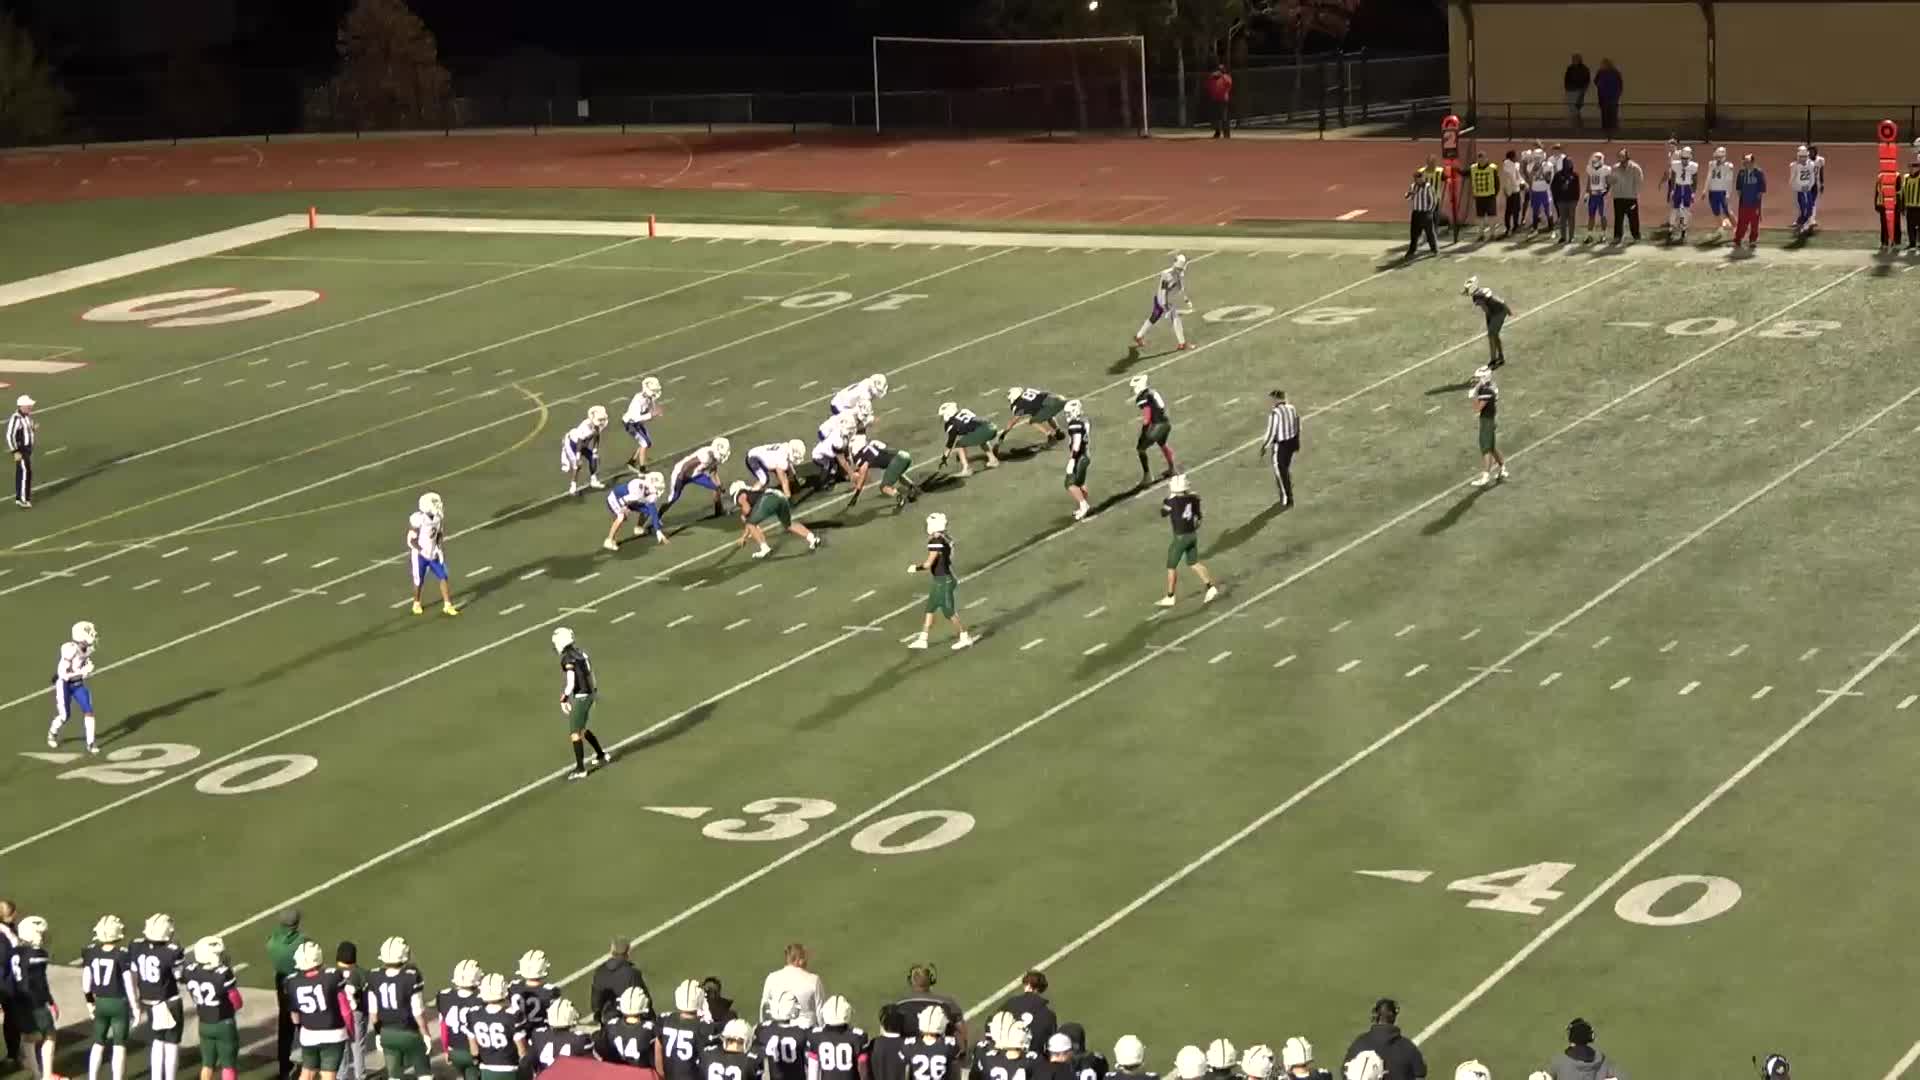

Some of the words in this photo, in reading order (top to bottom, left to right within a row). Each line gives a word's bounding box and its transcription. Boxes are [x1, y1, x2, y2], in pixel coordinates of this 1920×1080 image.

[1182, 503, 1193, 521] 4
[701, 797, 976, 854] 30
[1446, 861, 1742, 926] 40
[91, 958, 115, 987] 17
[137, 953, 160, 983] 16
[187, 980, 221, 1007] 32
[296, 984, 327, 1014] 51
[379, 982, 398, 1010] 11
[474, 1021, 508, 1050] 66
[614, 1035, 640, 1060] 14
[662, 1026, 694, 1061] 75
[765, 1035, 797, 1063] 40
[818, 1042, 853, 1071] 80
[911, 1054, 947, 1080] 26
